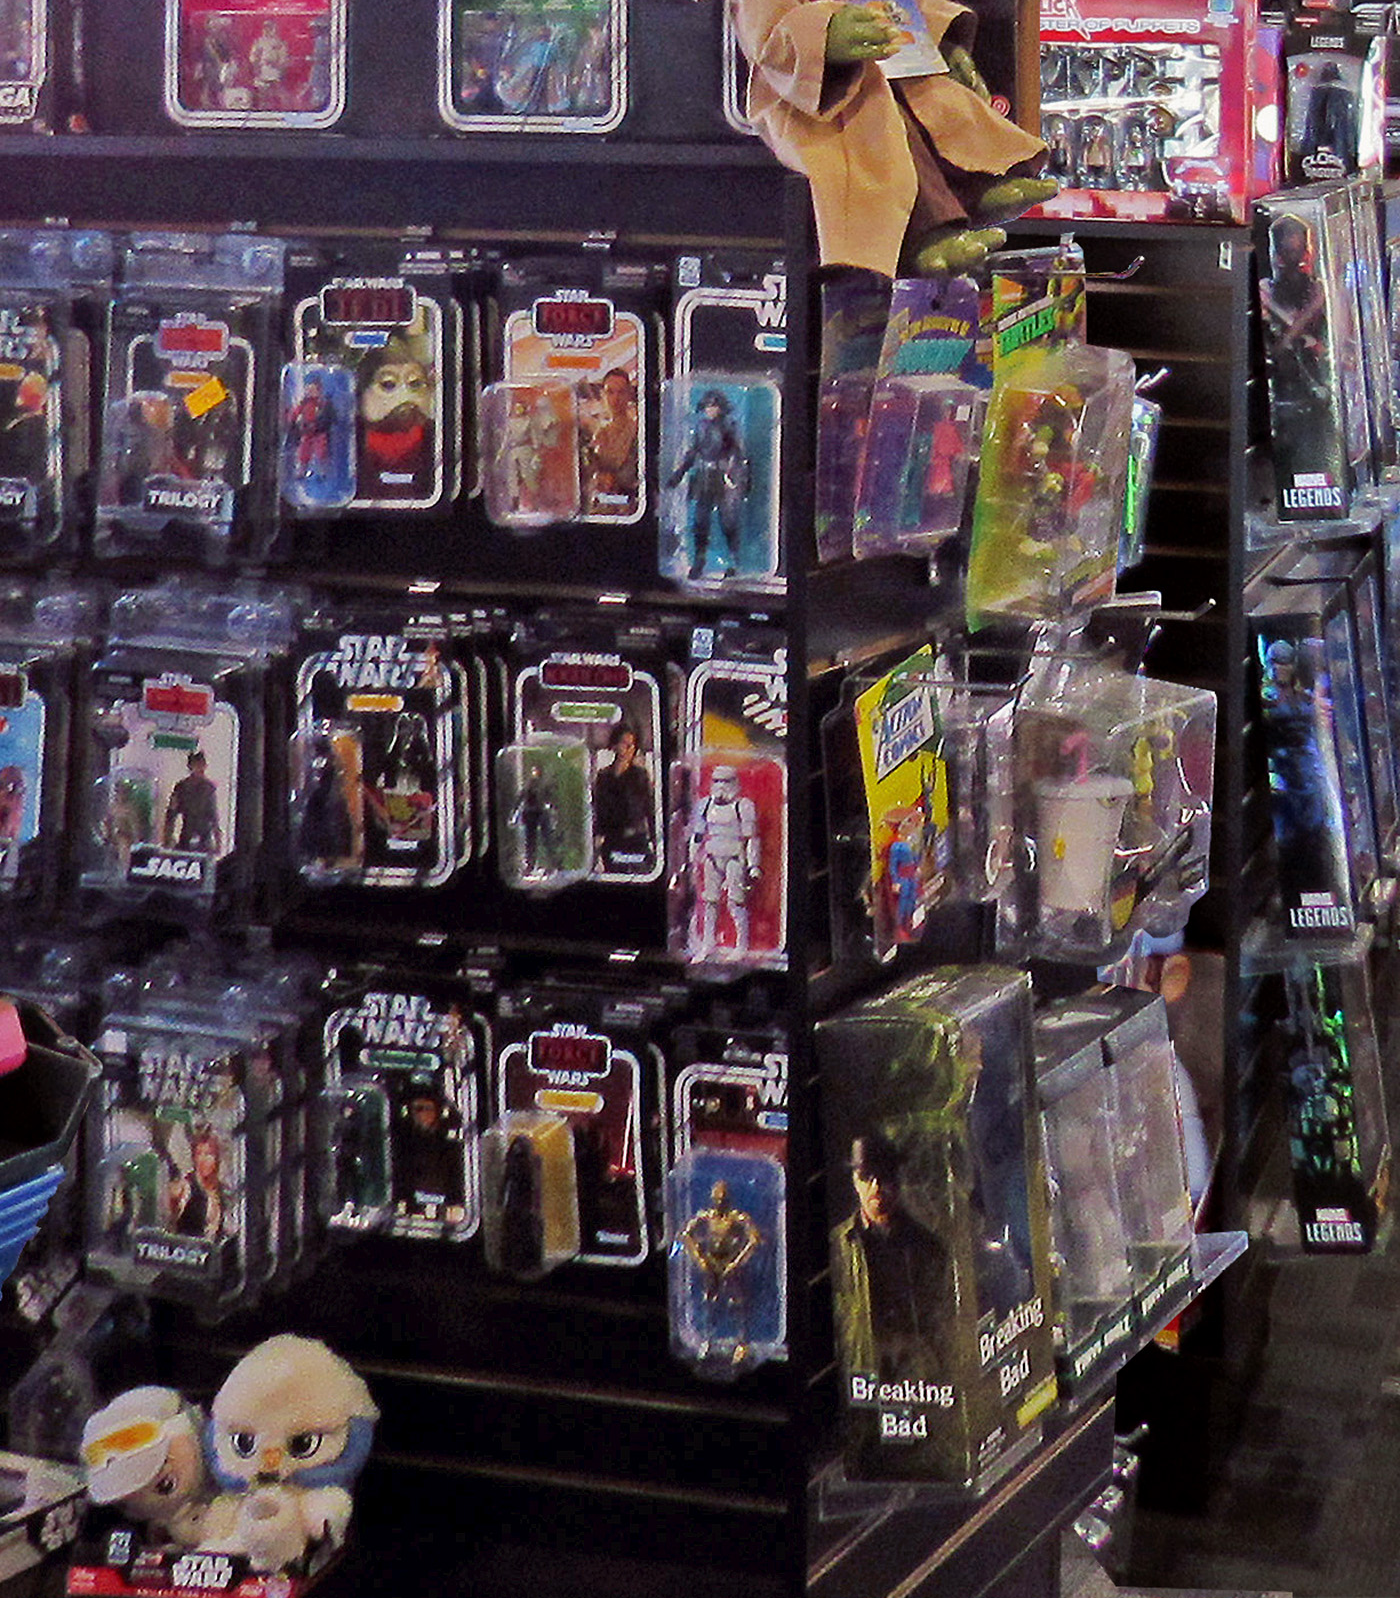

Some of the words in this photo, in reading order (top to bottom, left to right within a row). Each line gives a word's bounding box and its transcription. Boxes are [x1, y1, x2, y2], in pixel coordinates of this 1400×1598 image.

[1084, 19, 1111, 32] OF
[1112, 19, 1201, 34] PUPPETS
[551, 335, 594, 348] WARS
[149, 490, 222, 509] TRILOGY
[1283, 487, 1342, 509] LEGENDS
[133, 856, 202, 881] SAGA
[1290, 907, 1352, 928] LEGENDS
[548, 1071, 591, 1086] WARS
[1305, 1223, 1363, 1242] LEGENDS
[138, 1243, 209, 1264] TRILOGY
[978, 1297, 1044, 1367] Breaking
[1000, 1349, 1030, 1397] Bad
[852, 1377, 954, 1407] Breaking
[881, 1412, 928, 1439] Bad
[180, 1554, 230, 1570] STAR
[172, 1569, 233, 1588] WARS
